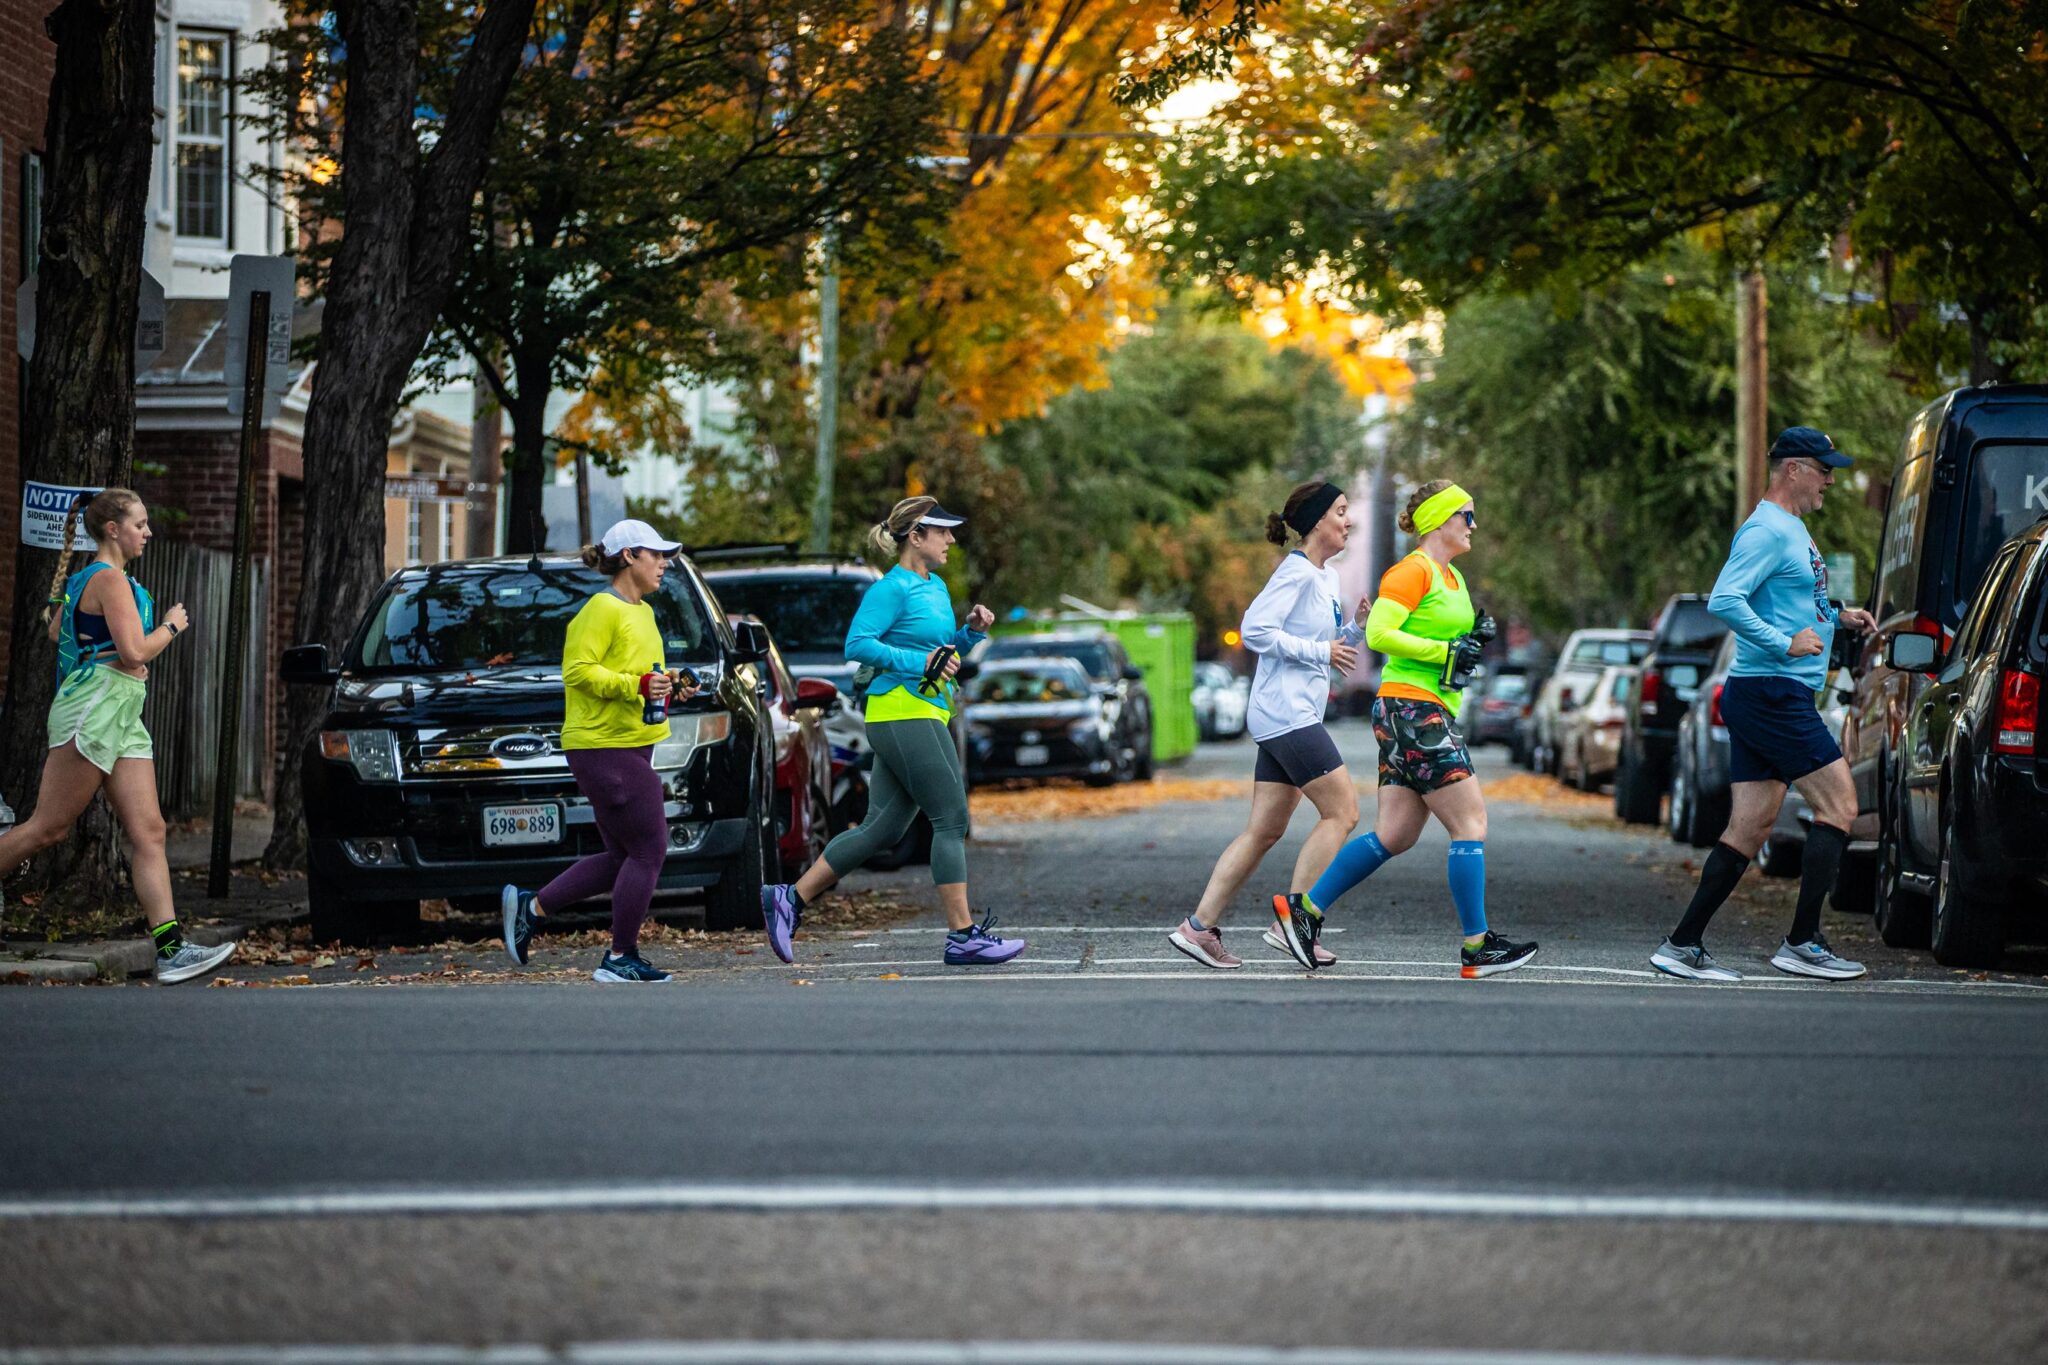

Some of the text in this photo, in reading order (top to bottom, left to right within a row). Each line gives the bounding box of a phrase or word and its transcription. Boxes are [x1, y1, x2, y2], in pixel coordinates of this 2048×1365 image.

[29, 488, 80, 509] NOTI
[27, 511, 64, 523] SIDEWALK
[46, 523, 65, 532] AHE
[504, 808, 539, 816] VIRGINIA
[490, 815, 554, 835] 698 889
